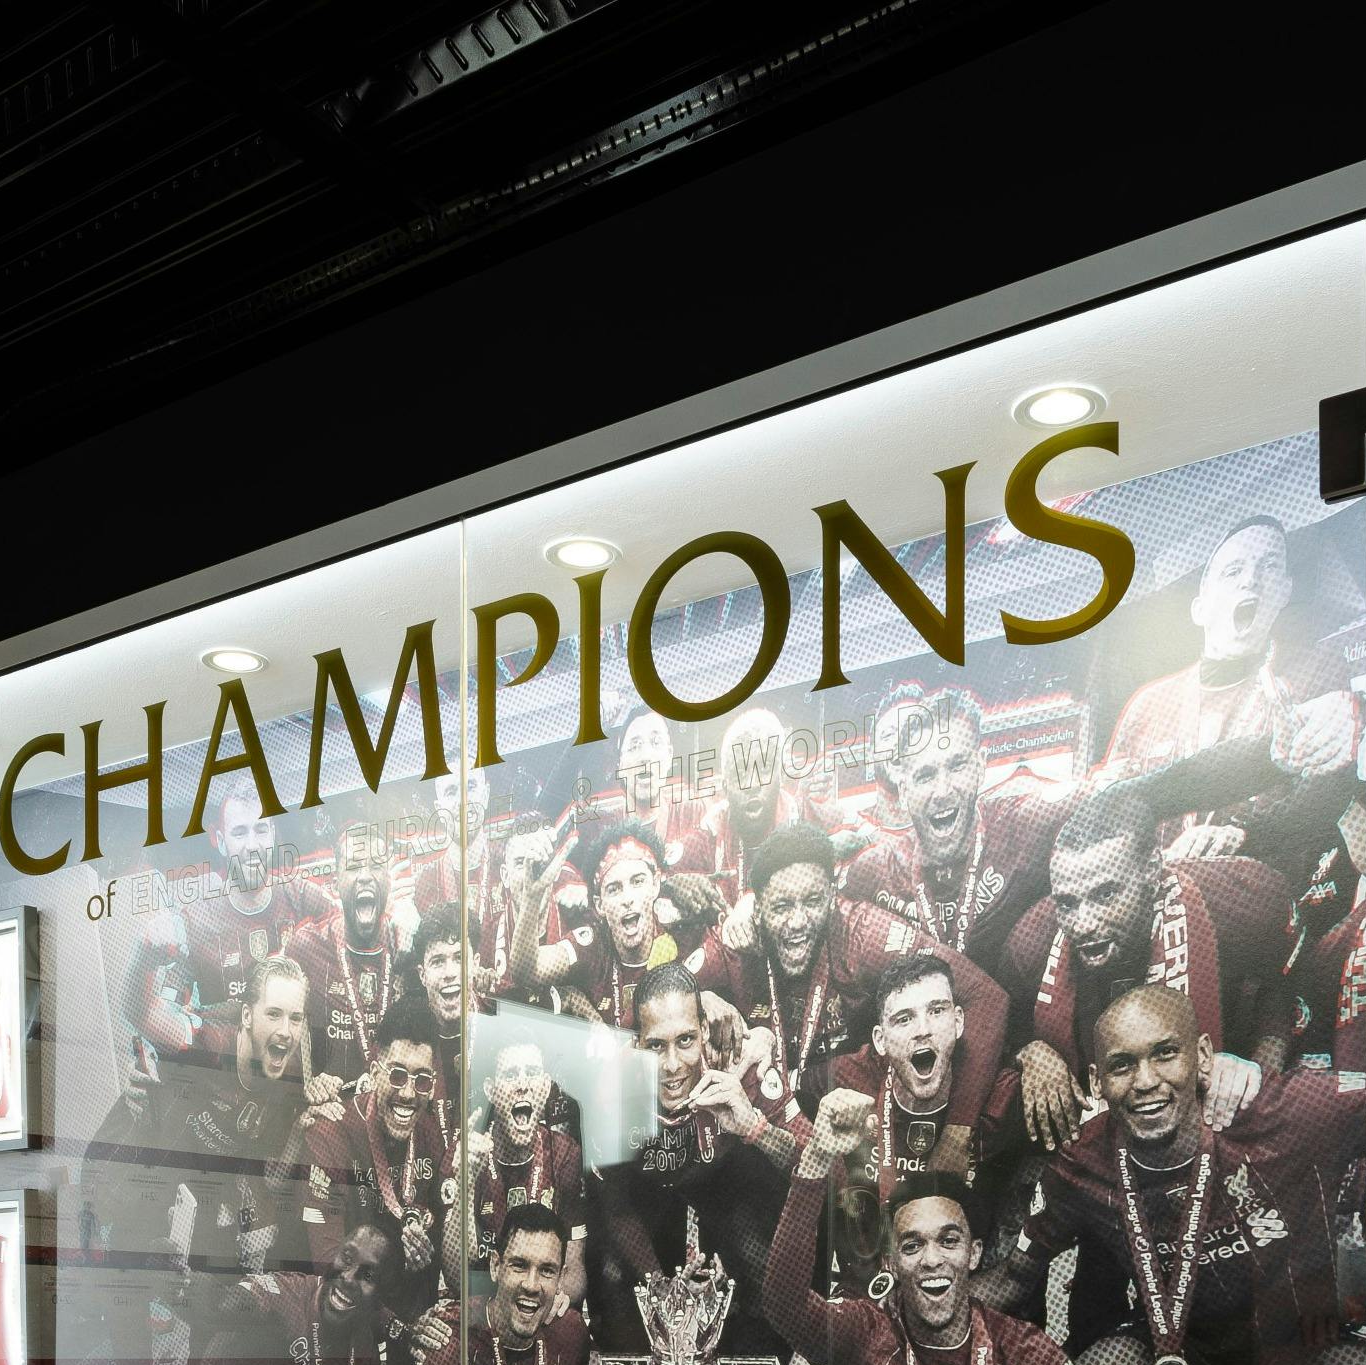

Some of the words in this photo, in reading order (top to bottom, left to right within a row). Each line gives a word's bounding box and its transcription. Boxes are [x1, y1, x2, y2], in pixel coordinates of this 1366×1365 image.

[87, 880, 116, 922] of
[616, 749, 717, 816] THE
[732, 697, 953, 791] WORLD!
[1118, 1148, 1132, 1191] Premier
[1126, 1192, 1142, 1234] League
[1191, 1154, 1210, 1198] League
[1183, 1200, 1202, 1243] Premier
